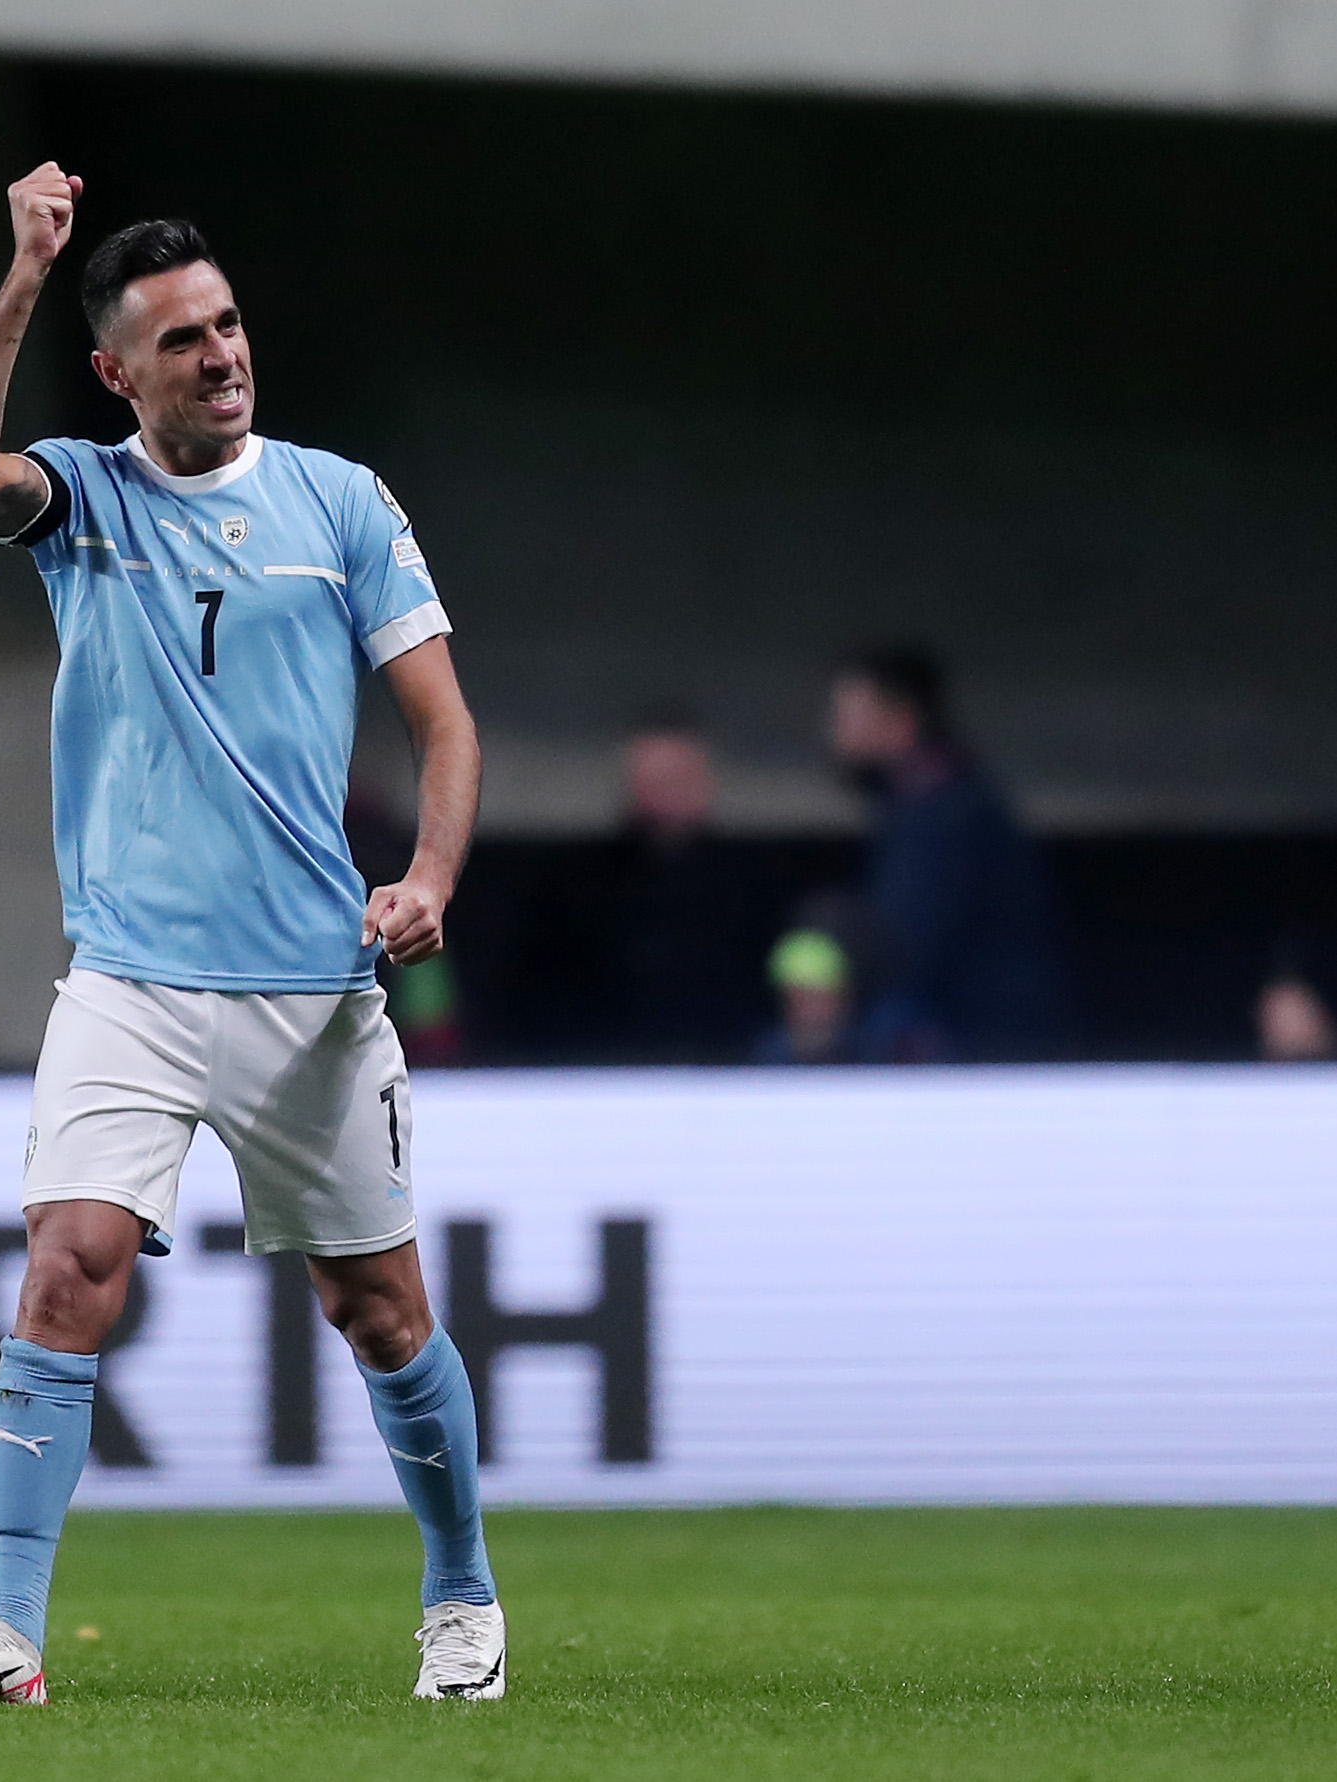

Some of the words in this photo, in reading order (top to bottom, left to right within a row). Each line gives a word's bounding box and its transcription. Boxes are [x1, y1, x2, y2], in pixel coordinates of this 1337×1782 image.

[163, 566, 247, 578] ISRAEL
[195, 590, 224, 675] 7
[379, 1084, 400, 1169] 7
